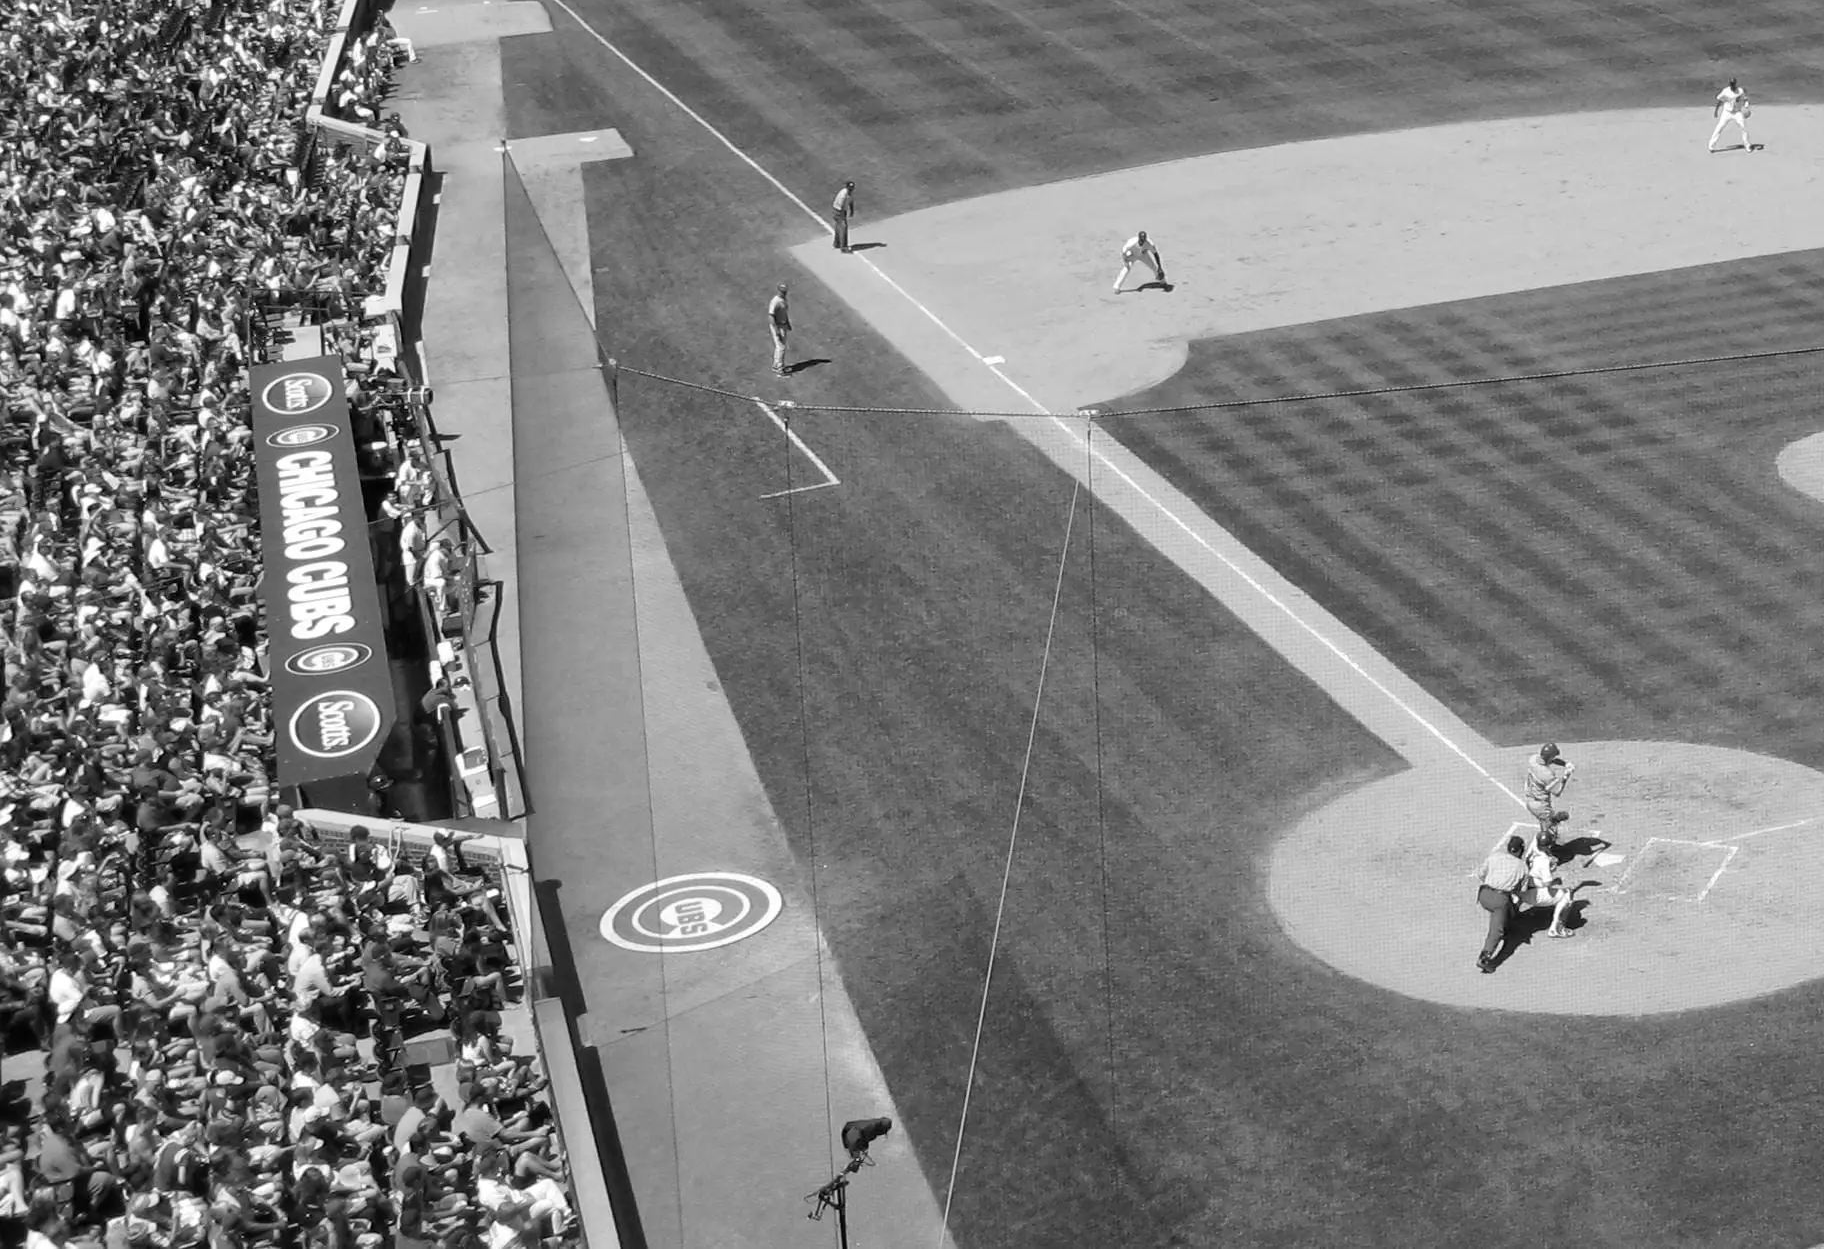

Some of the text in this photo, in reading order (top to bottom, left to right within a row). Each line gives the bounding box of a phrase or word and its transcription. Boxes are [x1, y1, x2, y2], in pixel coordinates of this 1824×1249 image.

[285, 379, 312, 410] Scotts
[276, 451, 345, 560] CHICAGO
[286, 561, 356, 639] CUBS
